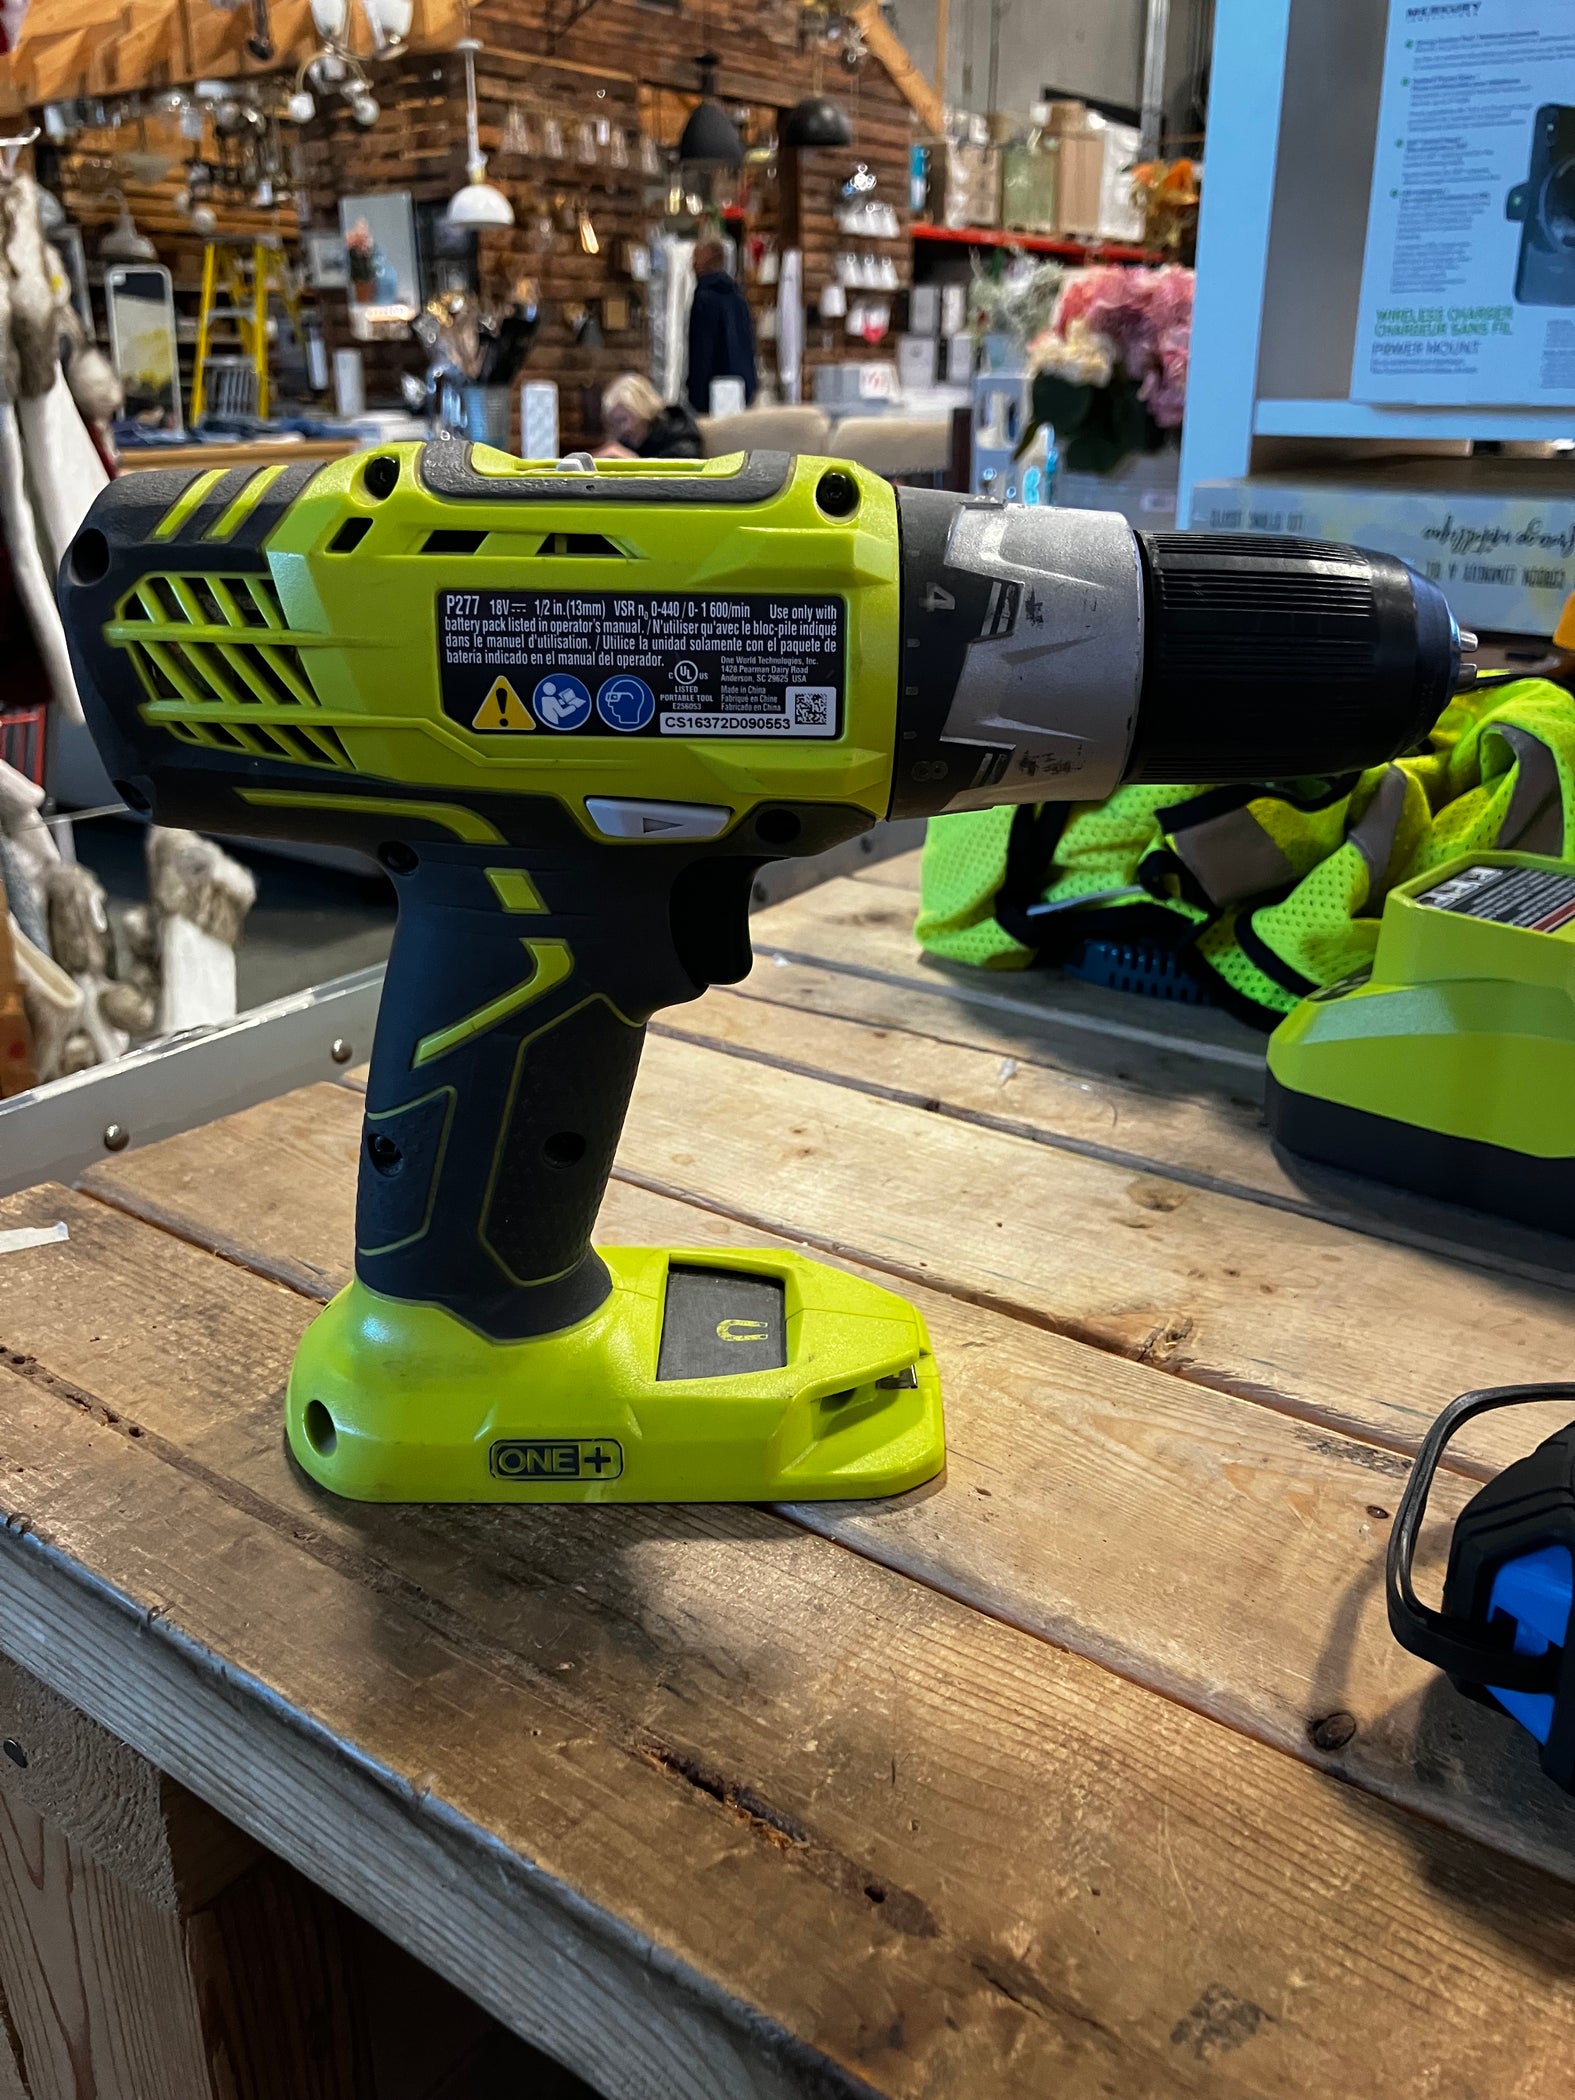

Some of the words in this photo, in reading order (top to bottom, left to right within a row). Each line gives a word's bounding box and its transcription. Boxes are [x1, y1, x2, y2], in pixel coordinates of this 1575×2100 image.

[920, 582, 956, 612] 4
[446, 594, 480, 615] P277
[489, 599, 510, 616] 18V
[534, 599, 550, 617] 1/2
[613, 600, 635, 617] VSR
[769, 604, 788, 619] Use
[791, 604, 813, 622] only
[816, 604, 837, 620] with
[445, 617, 480, 635] battery
[482, 618, 506, 635] pack
[508, 617, 536, 632] listed
[538, 618, 548, 632] in
[550, 618, 601, 635] operator's
[603, 618, 644, 634] manual.
[652, 619, 699, 635] N'utiliser
[700, 620, 740, 639] qu'avec
[741, 620, 751, 635] le
[753, 620, 798, 638] bloc-pile
[799, 621, 837, 639] indiqué
[445, 633, 470, 648] dans
[473, 632, 483, 648] le
[486, 634, 525, 648] manuel
[528, 634, 592, 649] d'utilisation.
[602, 634, 636, 650] Utilice
[639, 635, 649, 650] la
[652, 636, 687, 651] unidad
[689, 636, 743, 651] solamente
[746, 640, 762, 651] con
[767, 638, 777, 652] el
[780, 638, 821, 655] paquete
[824, 638, 837, 652] de
[446, 649, 482, 664] batería
[484, 650, 528, 665] indicado
[530, 653, 543, 665] en
[545, 651, 555, 665] el
[558, 651, 595, 666] manual
[598, 651, 614, 666] del
[617, 652, 665, 669] operador.
[720, 656, 735, 664] One
[736, 656, 756, 665] World
[680, 665, 693, 680] UL
[699, 672, 709, 680] US
[792, 675, 807, 683] USA
[674, 685, 699, 693] LISTED
[720, 685, 739, 694] Made
[748, 685, 766, 694] China
[659, 694, 695, 702] PORTABLE
[696, 694, 714, 702] TOOL
[664, 716, 791, 730] CS16372D090553
